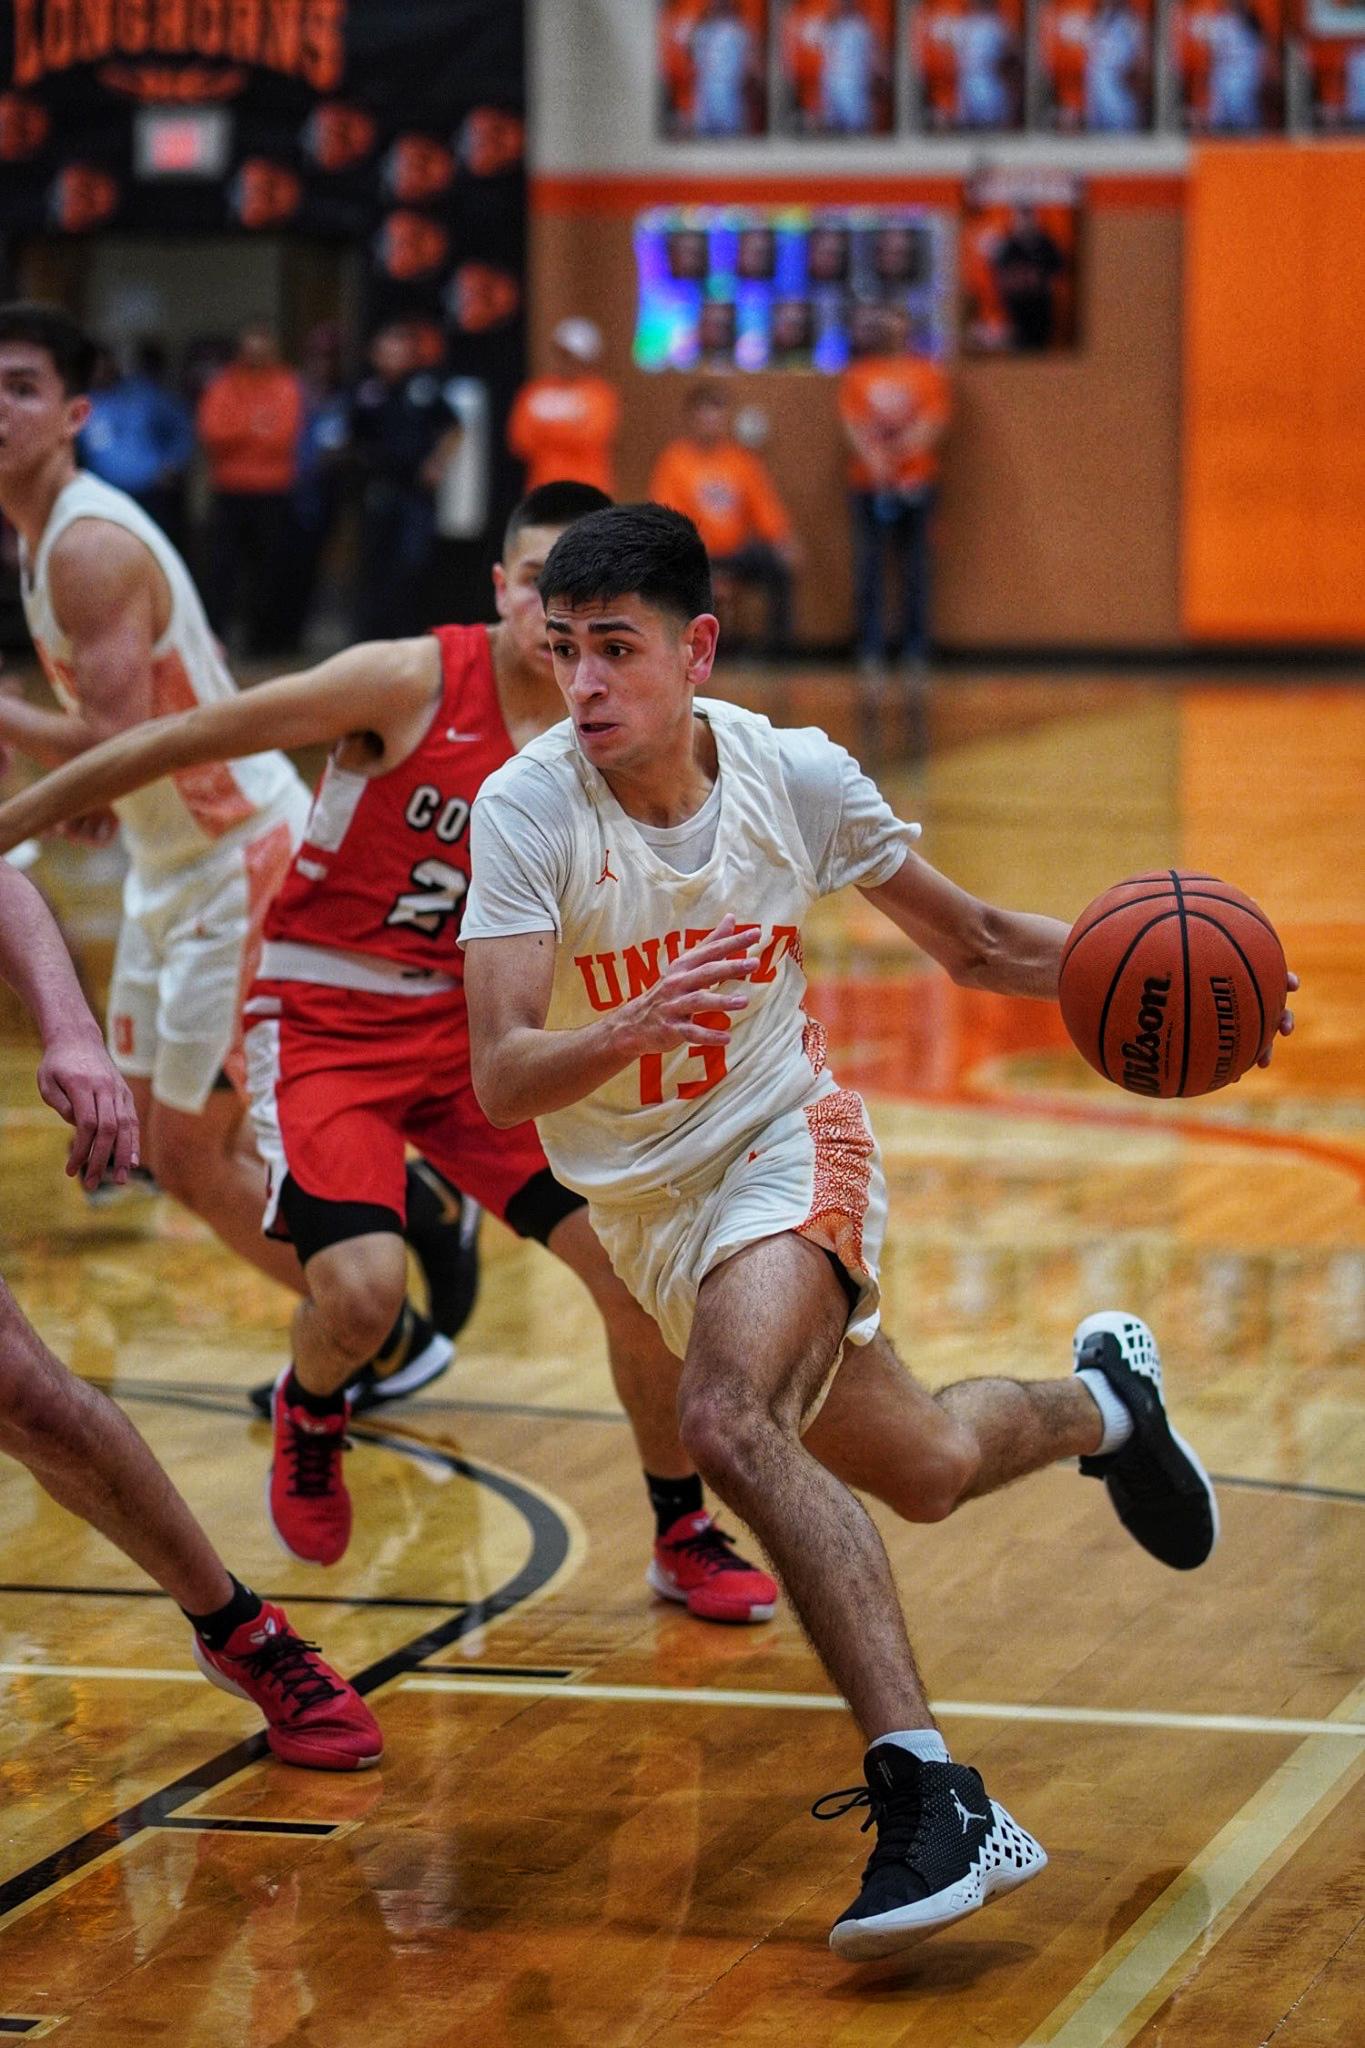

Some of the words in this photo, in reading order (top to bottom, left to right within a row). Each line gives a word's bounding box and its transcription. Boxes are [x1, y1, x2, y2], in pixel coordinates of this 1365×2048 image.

[12, 0, 344, 88] LONGHORNS
[639, 1010, 732, 1106] 13
[1121, 977, 1171, 1096] Wilson
